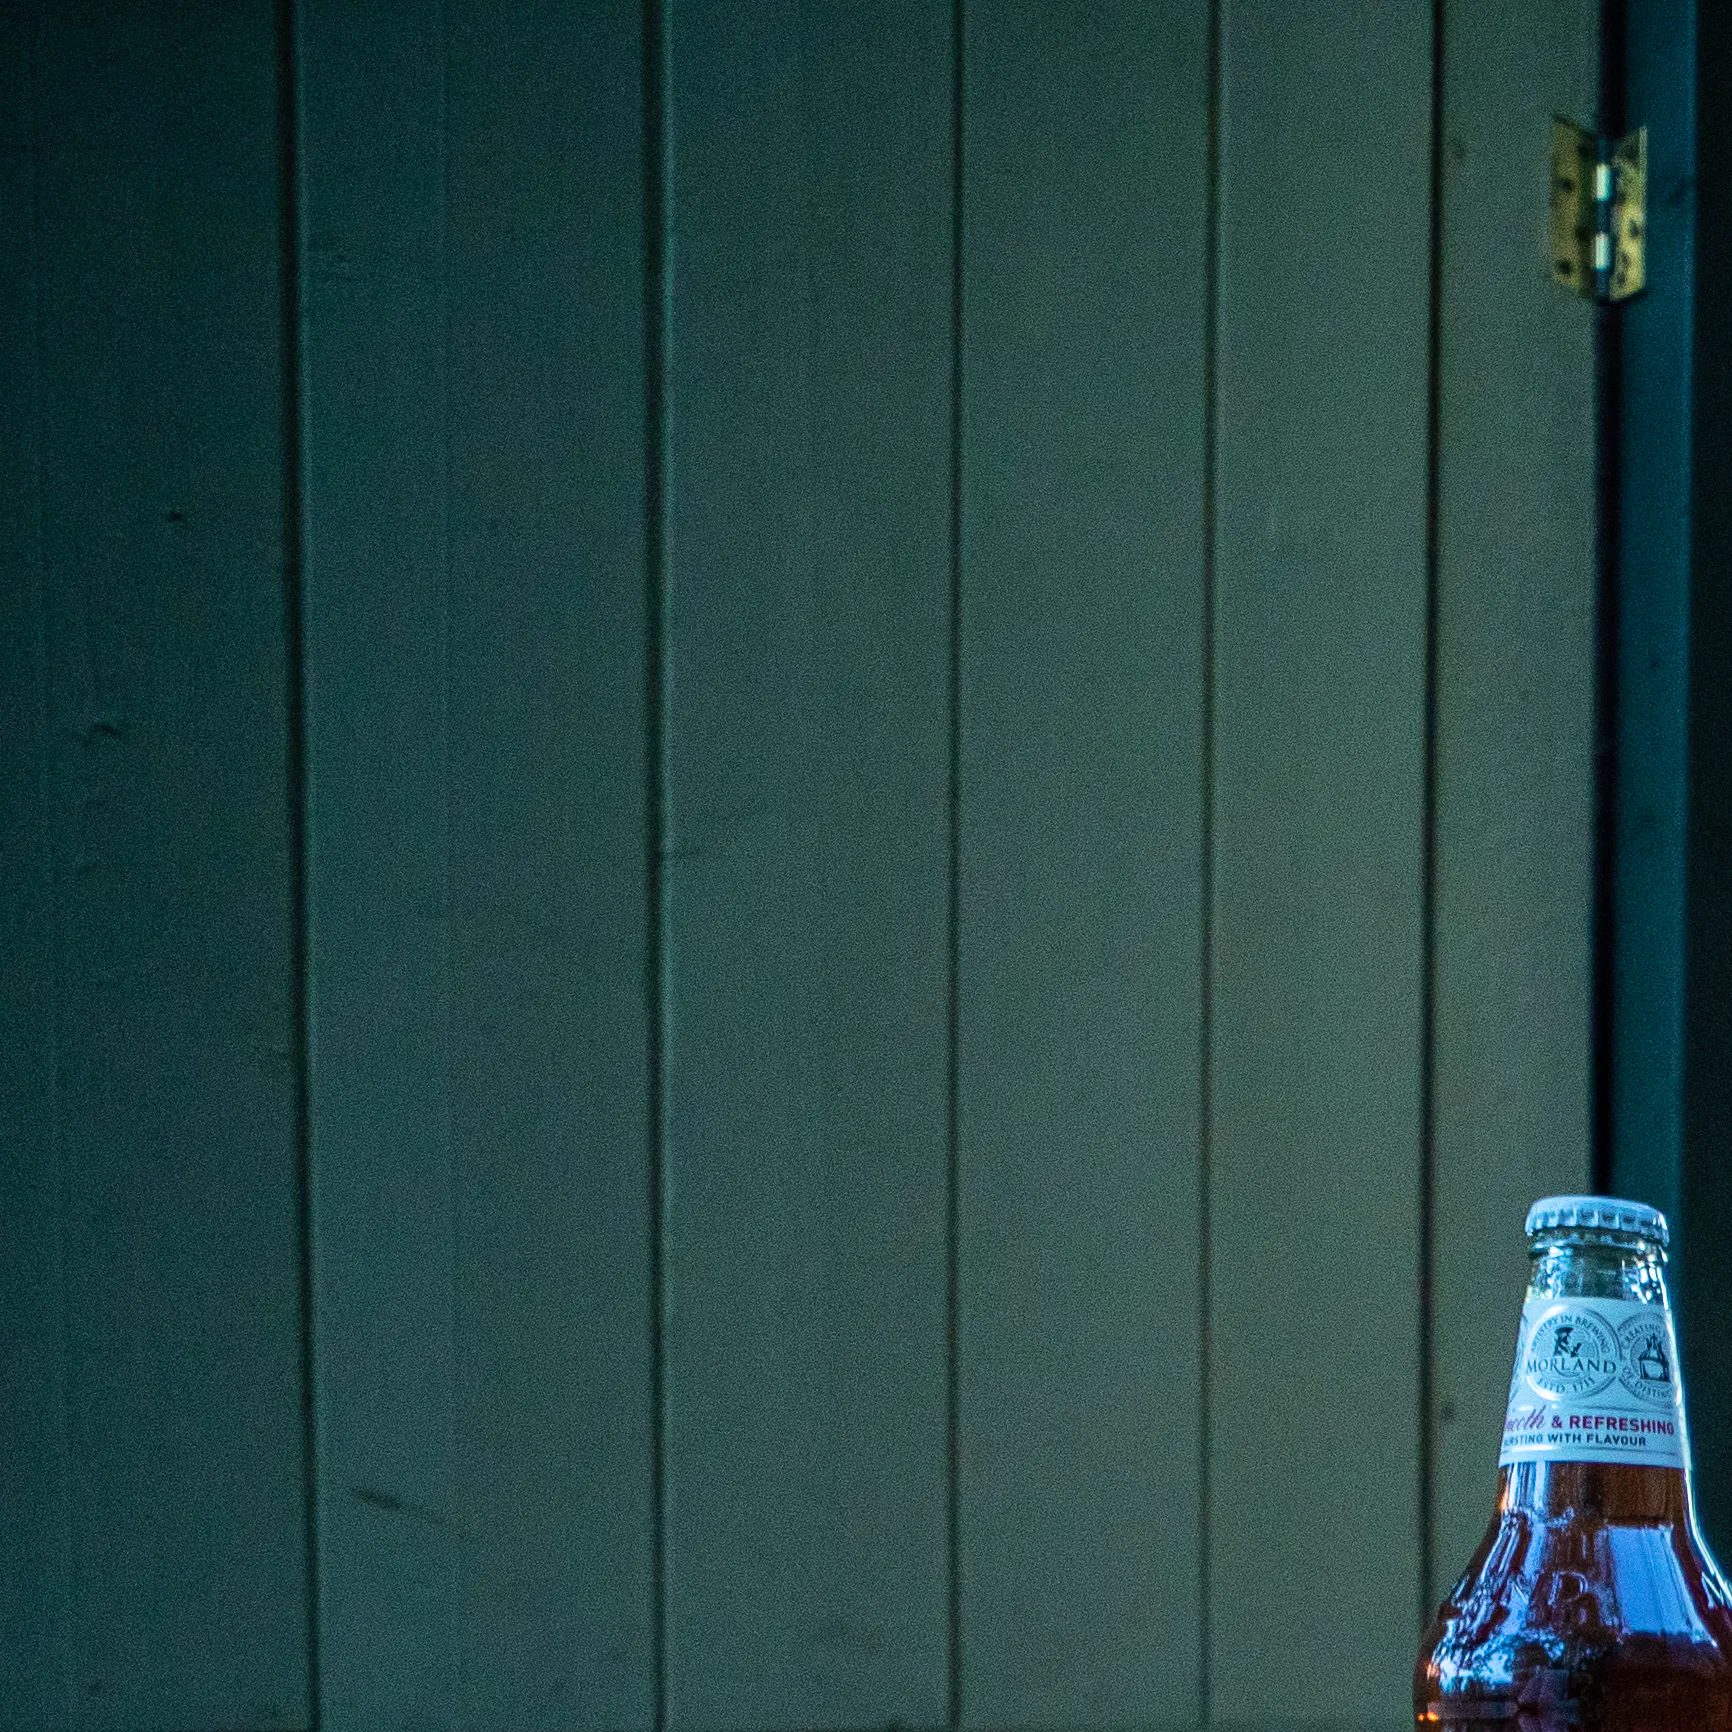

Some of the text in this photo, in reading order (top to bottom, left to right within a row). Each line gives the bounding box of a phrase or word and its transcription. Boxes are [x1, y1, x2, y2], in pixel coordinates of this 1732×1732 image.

[1525, 1358, 1617, 1375] MORLAND
[1551, 1415, 1562, 1428] &
[1569, 1415, 1675, 1436] REFRESHING
[1548, 1433, 1581, 1443] WITH
[1586, 1434, 1646, 1447] FLAVOUR
